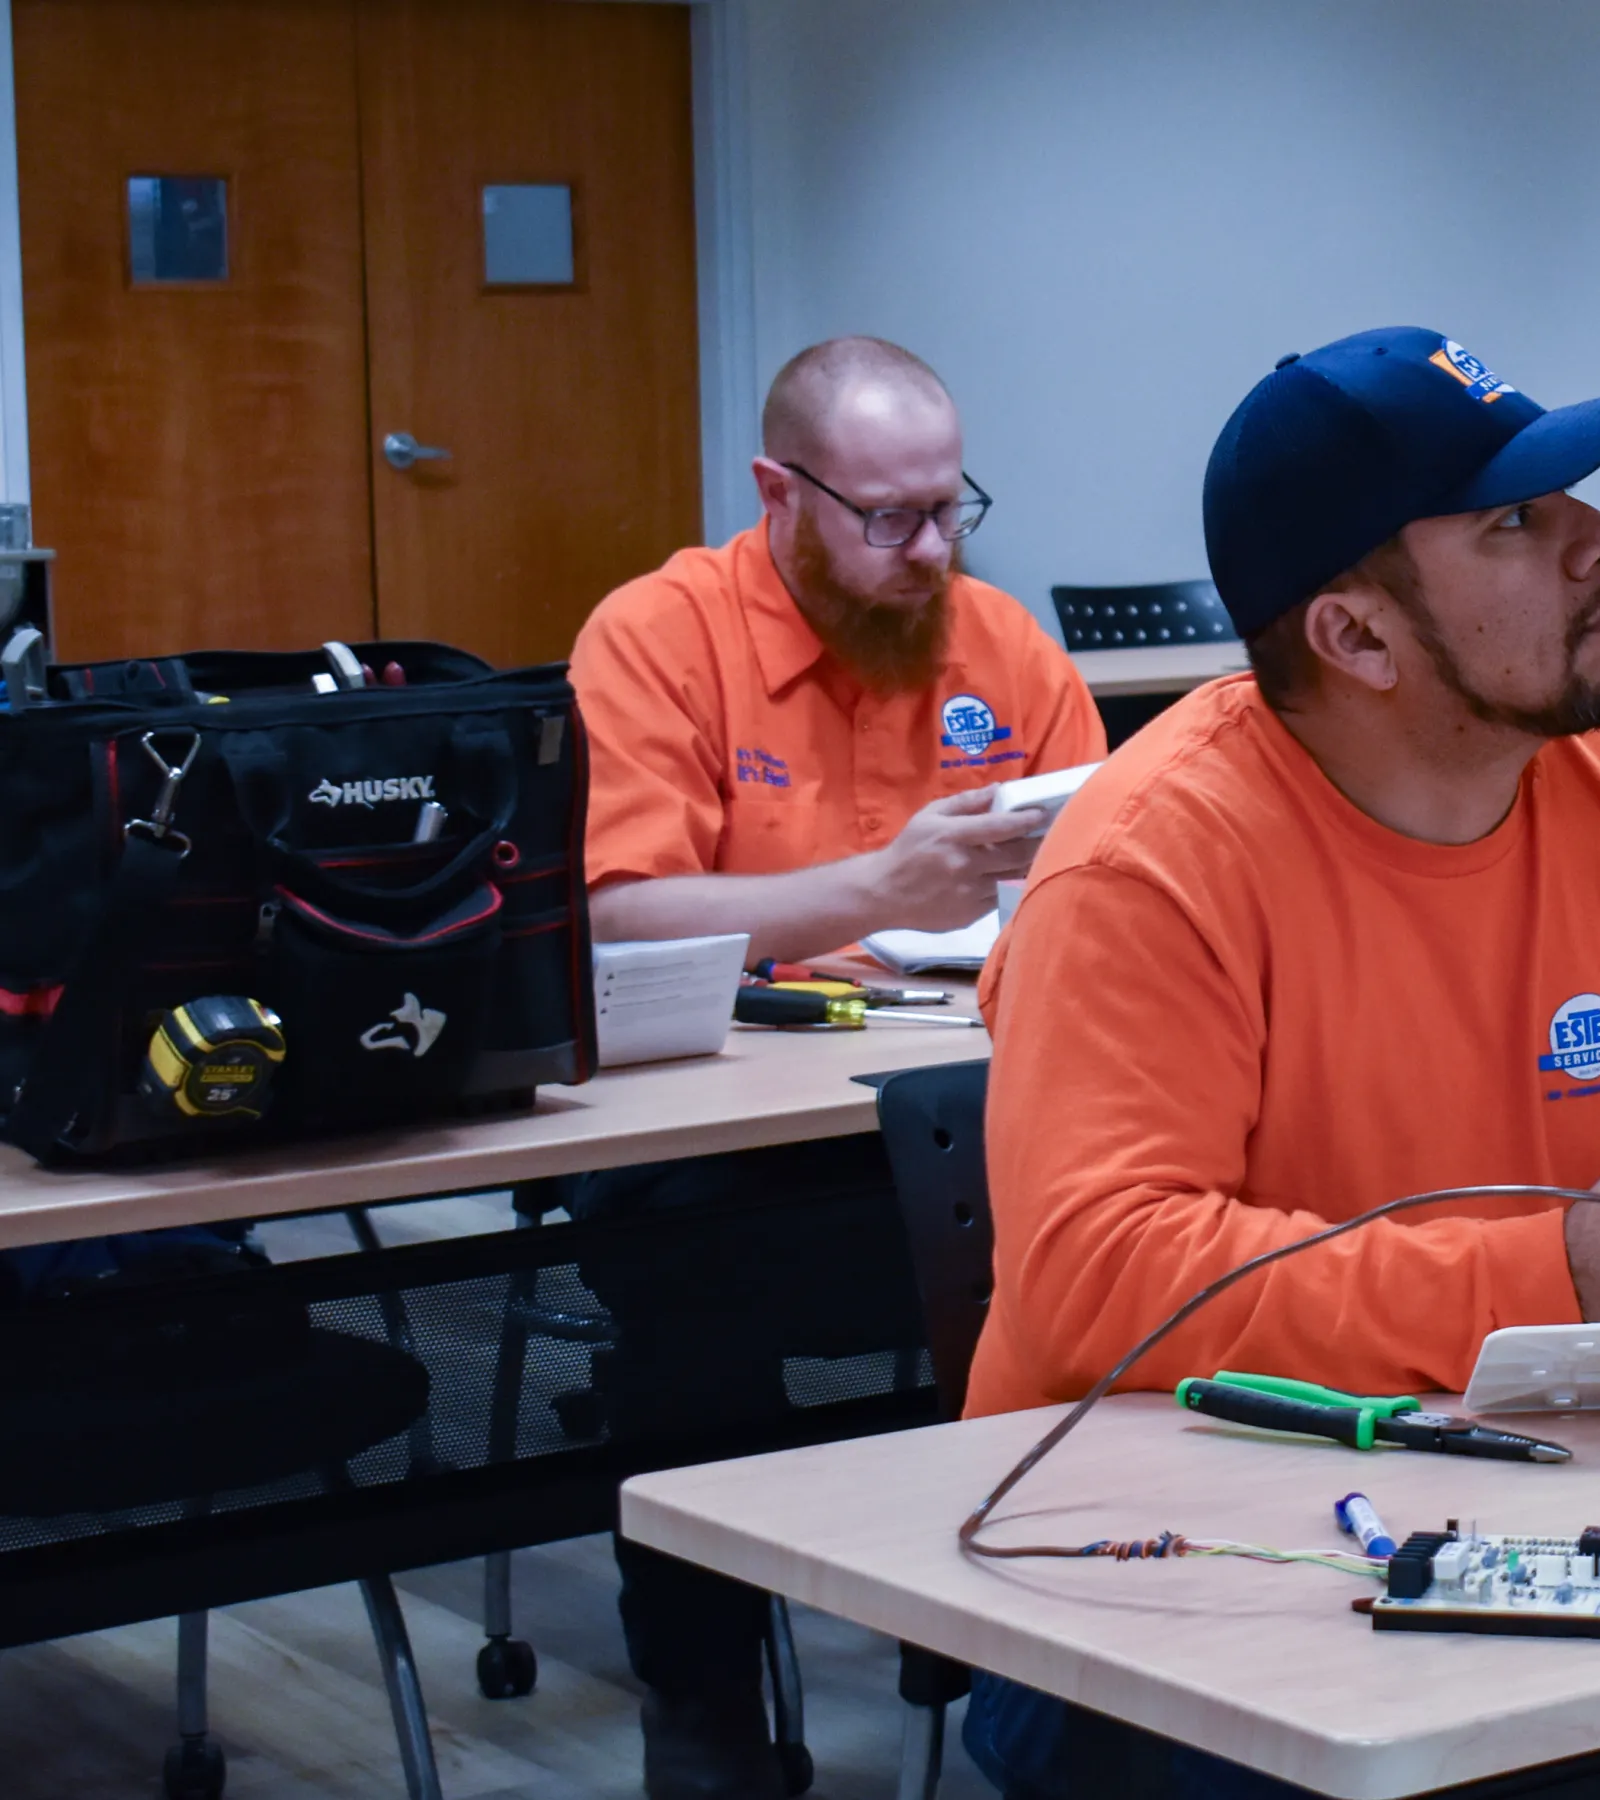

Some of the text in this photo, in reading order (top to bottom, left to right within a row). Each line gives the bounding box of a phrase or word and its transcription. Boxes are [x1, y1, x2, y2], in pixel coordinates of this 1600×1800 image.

[945, 705, 990, 733] ESTES
[951, 732, 994, 744] SERVICES
[342, 775, 434, 804] HUSKY
[203, 1064, 255, 1074] STANLEY
